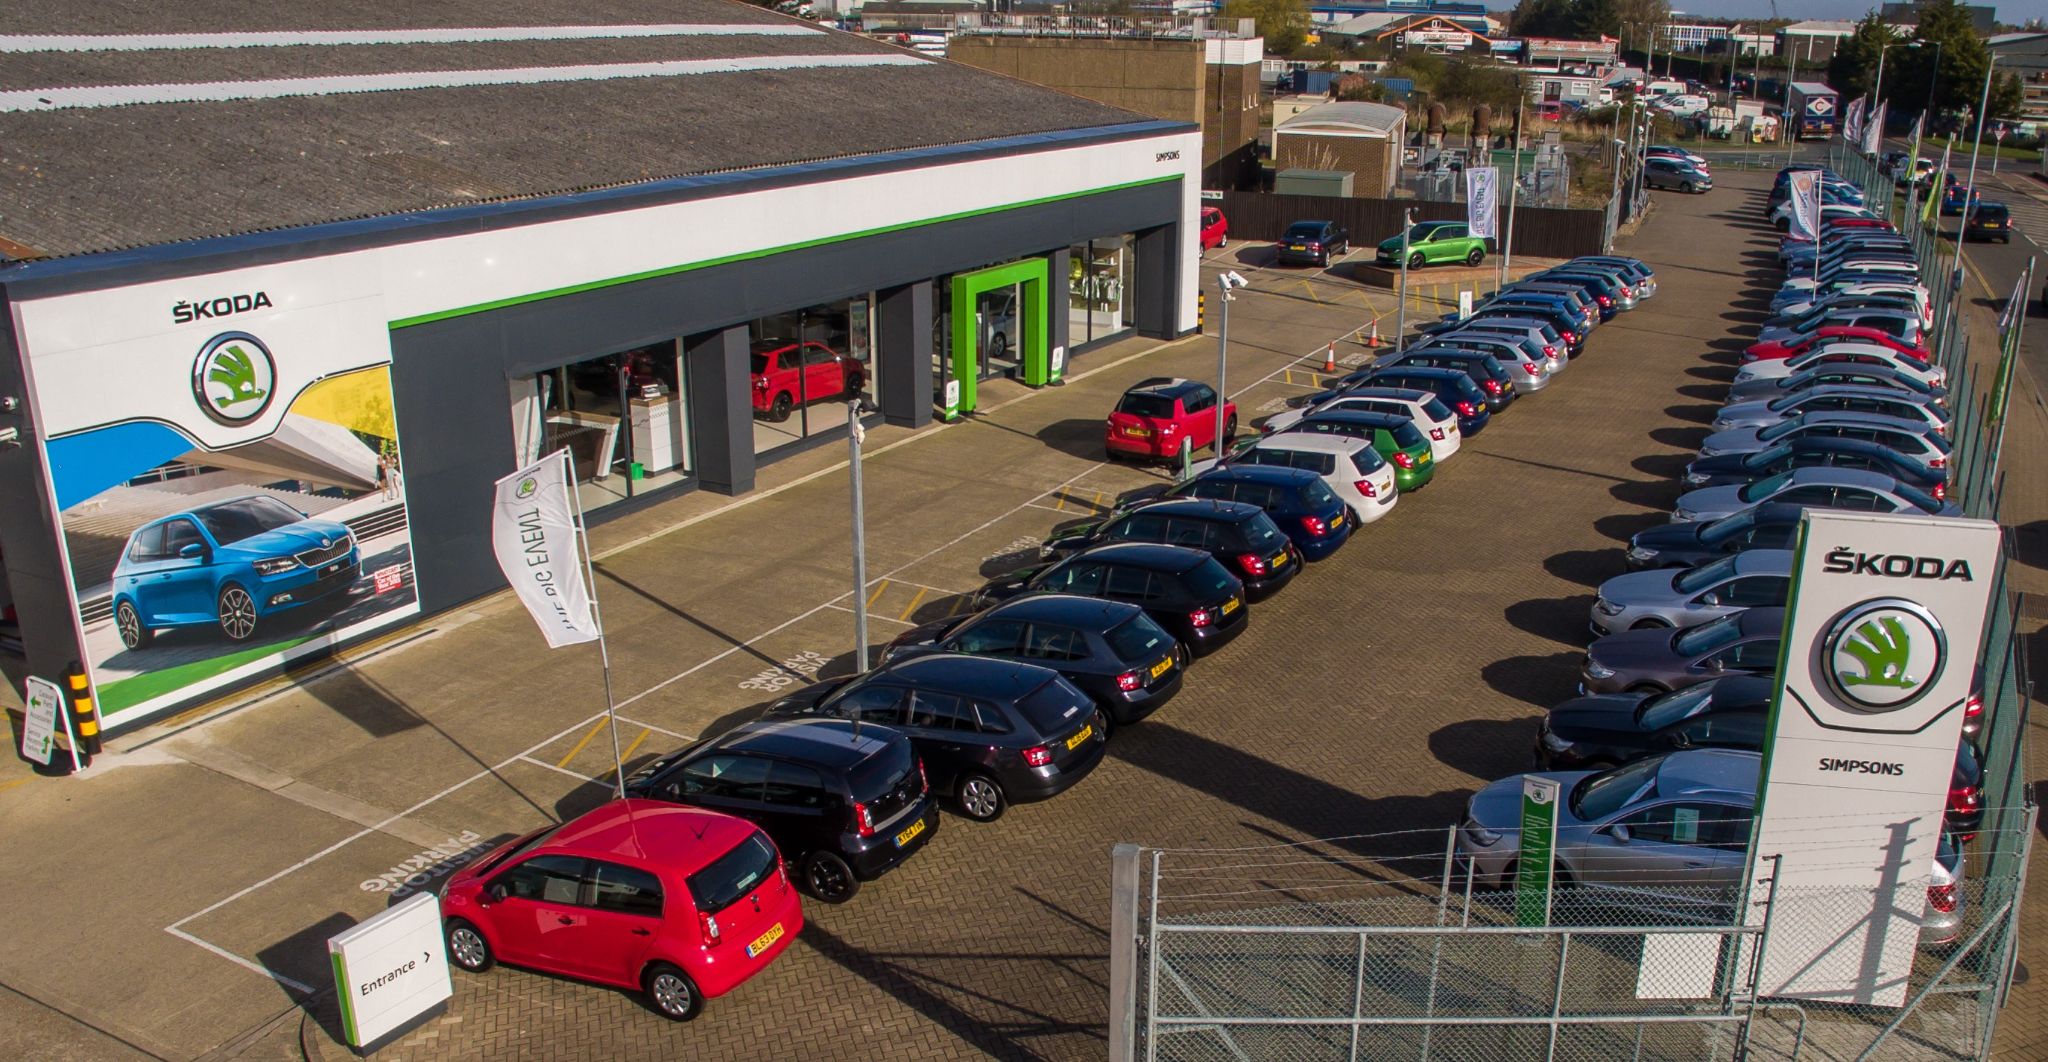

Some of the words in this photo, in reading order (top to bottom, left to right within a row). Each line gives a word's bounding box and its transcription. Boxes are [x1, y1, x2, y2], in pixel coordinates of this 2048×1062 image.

[1156, 150, 1180, 162] SIMPSONS
[172, 291, 273, 324] ŠKODA
[1822, 546, 1973, 582] ŠKODA
[1819, 758, 1904, 776] SIMPSONS
[360, 829, 481, 892] PARKING
[750, 934, 770, 954] BL63
[361, 960, 416, 996] Entrance
